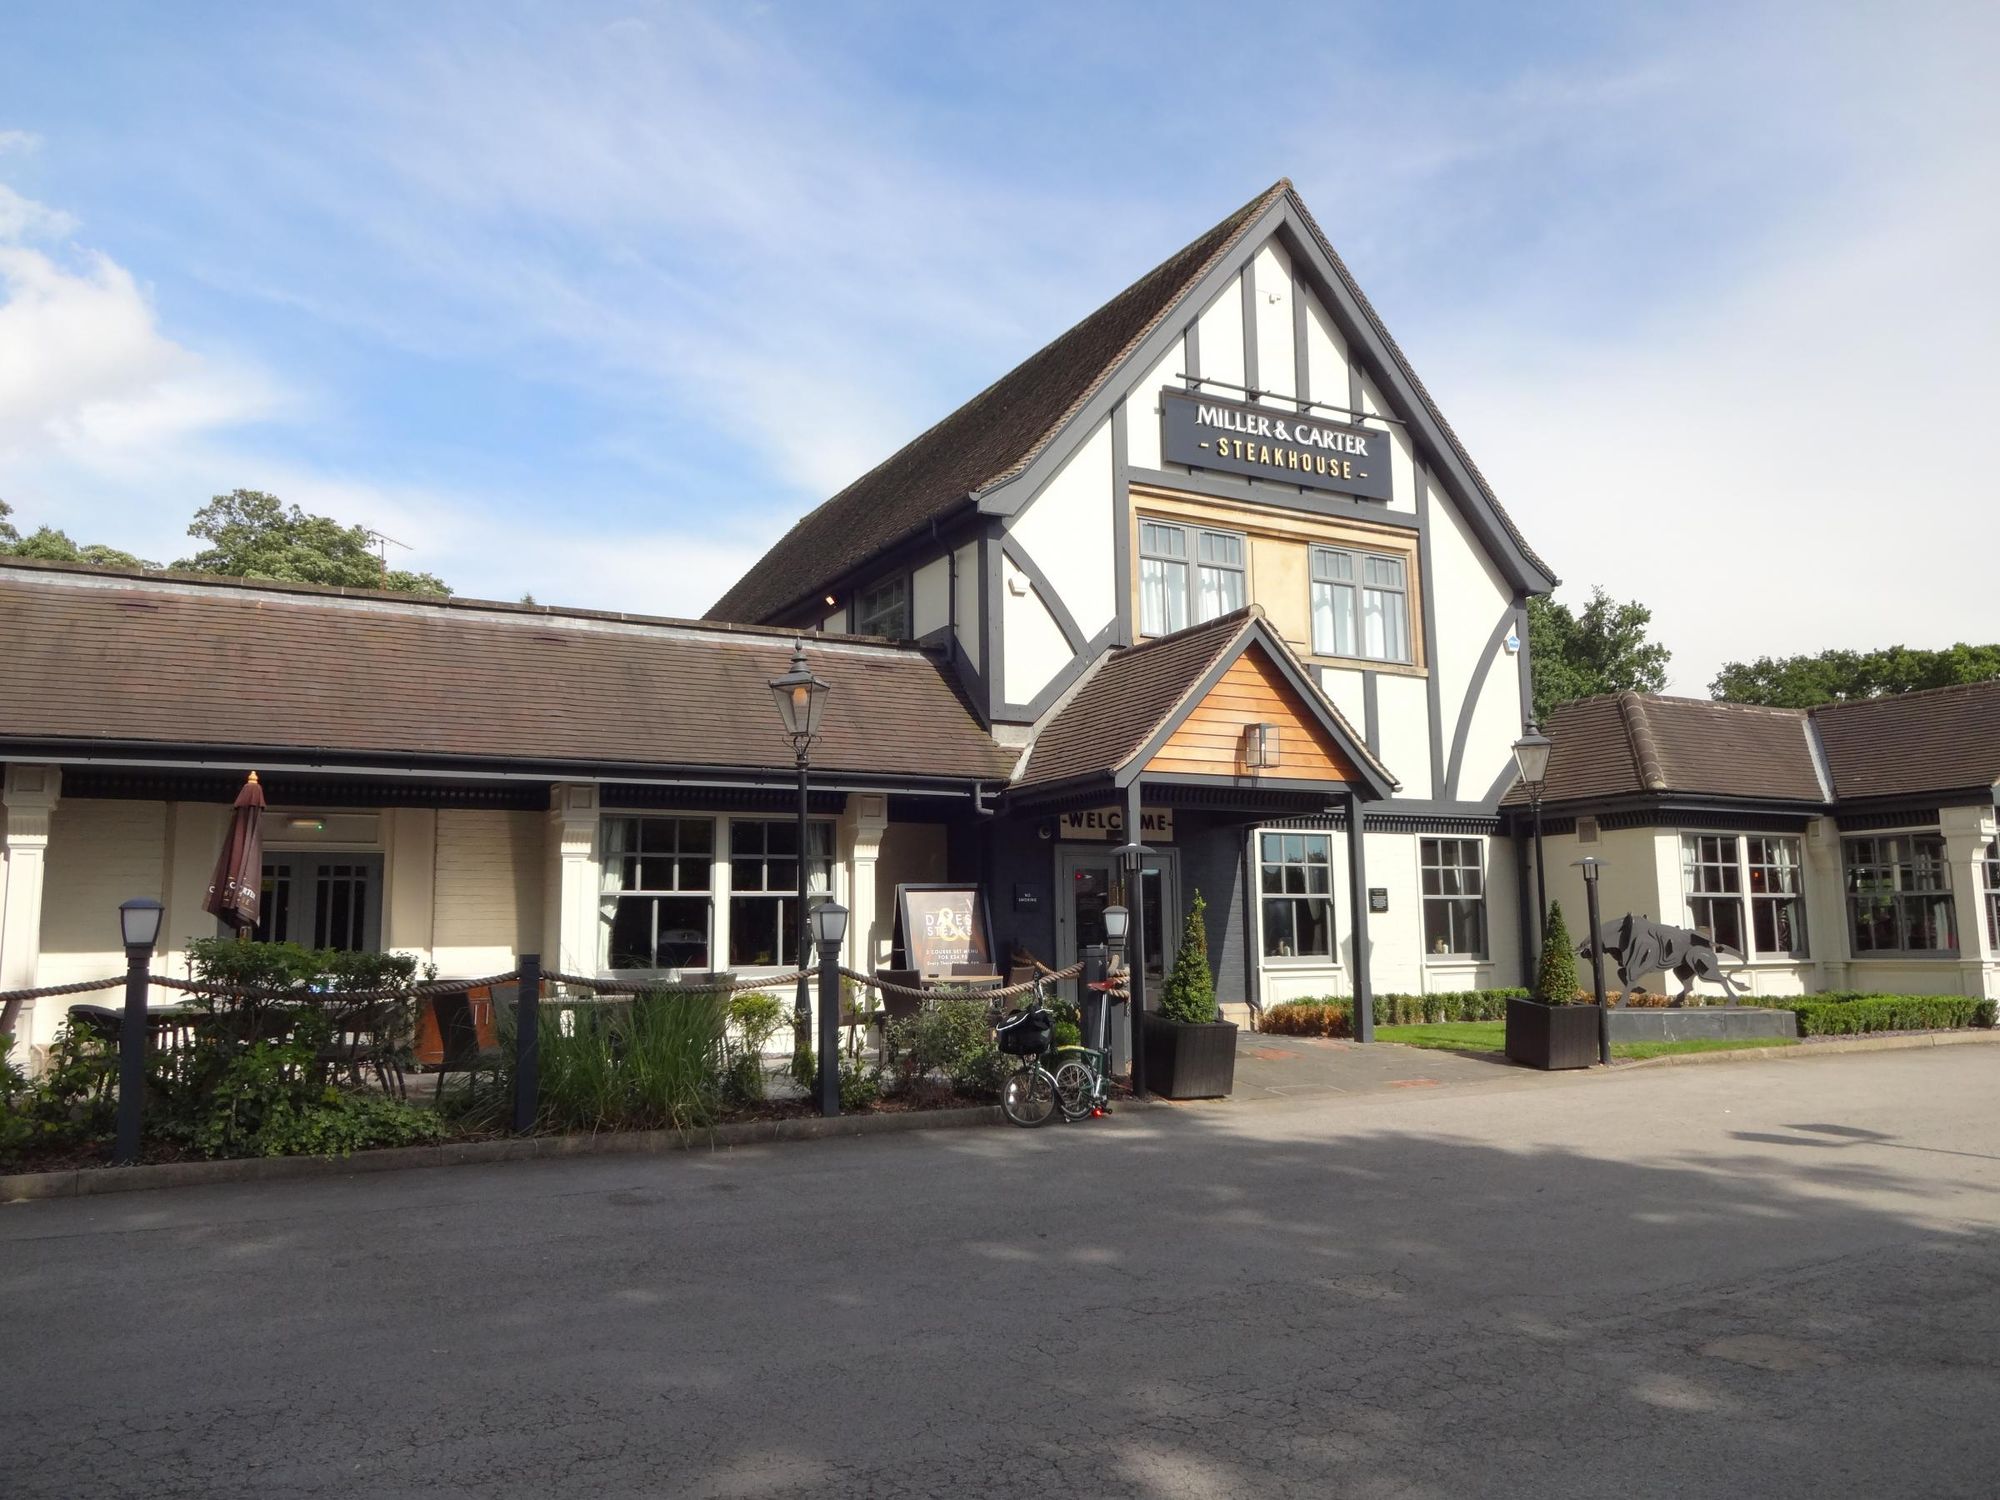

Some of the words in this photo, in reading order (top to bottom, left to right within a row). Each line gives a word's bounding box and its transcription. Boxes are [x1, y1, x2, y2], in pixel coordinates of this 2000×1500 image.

[1195, 404, 1272, 438] MILLER
[1273, 420, 1293, 442] &
[1294, 424, 1368, 456] CARTER
[1218, 437, 1352, 479] STEAKHOUSE
[927, 926, 973, 937] STEAKS
